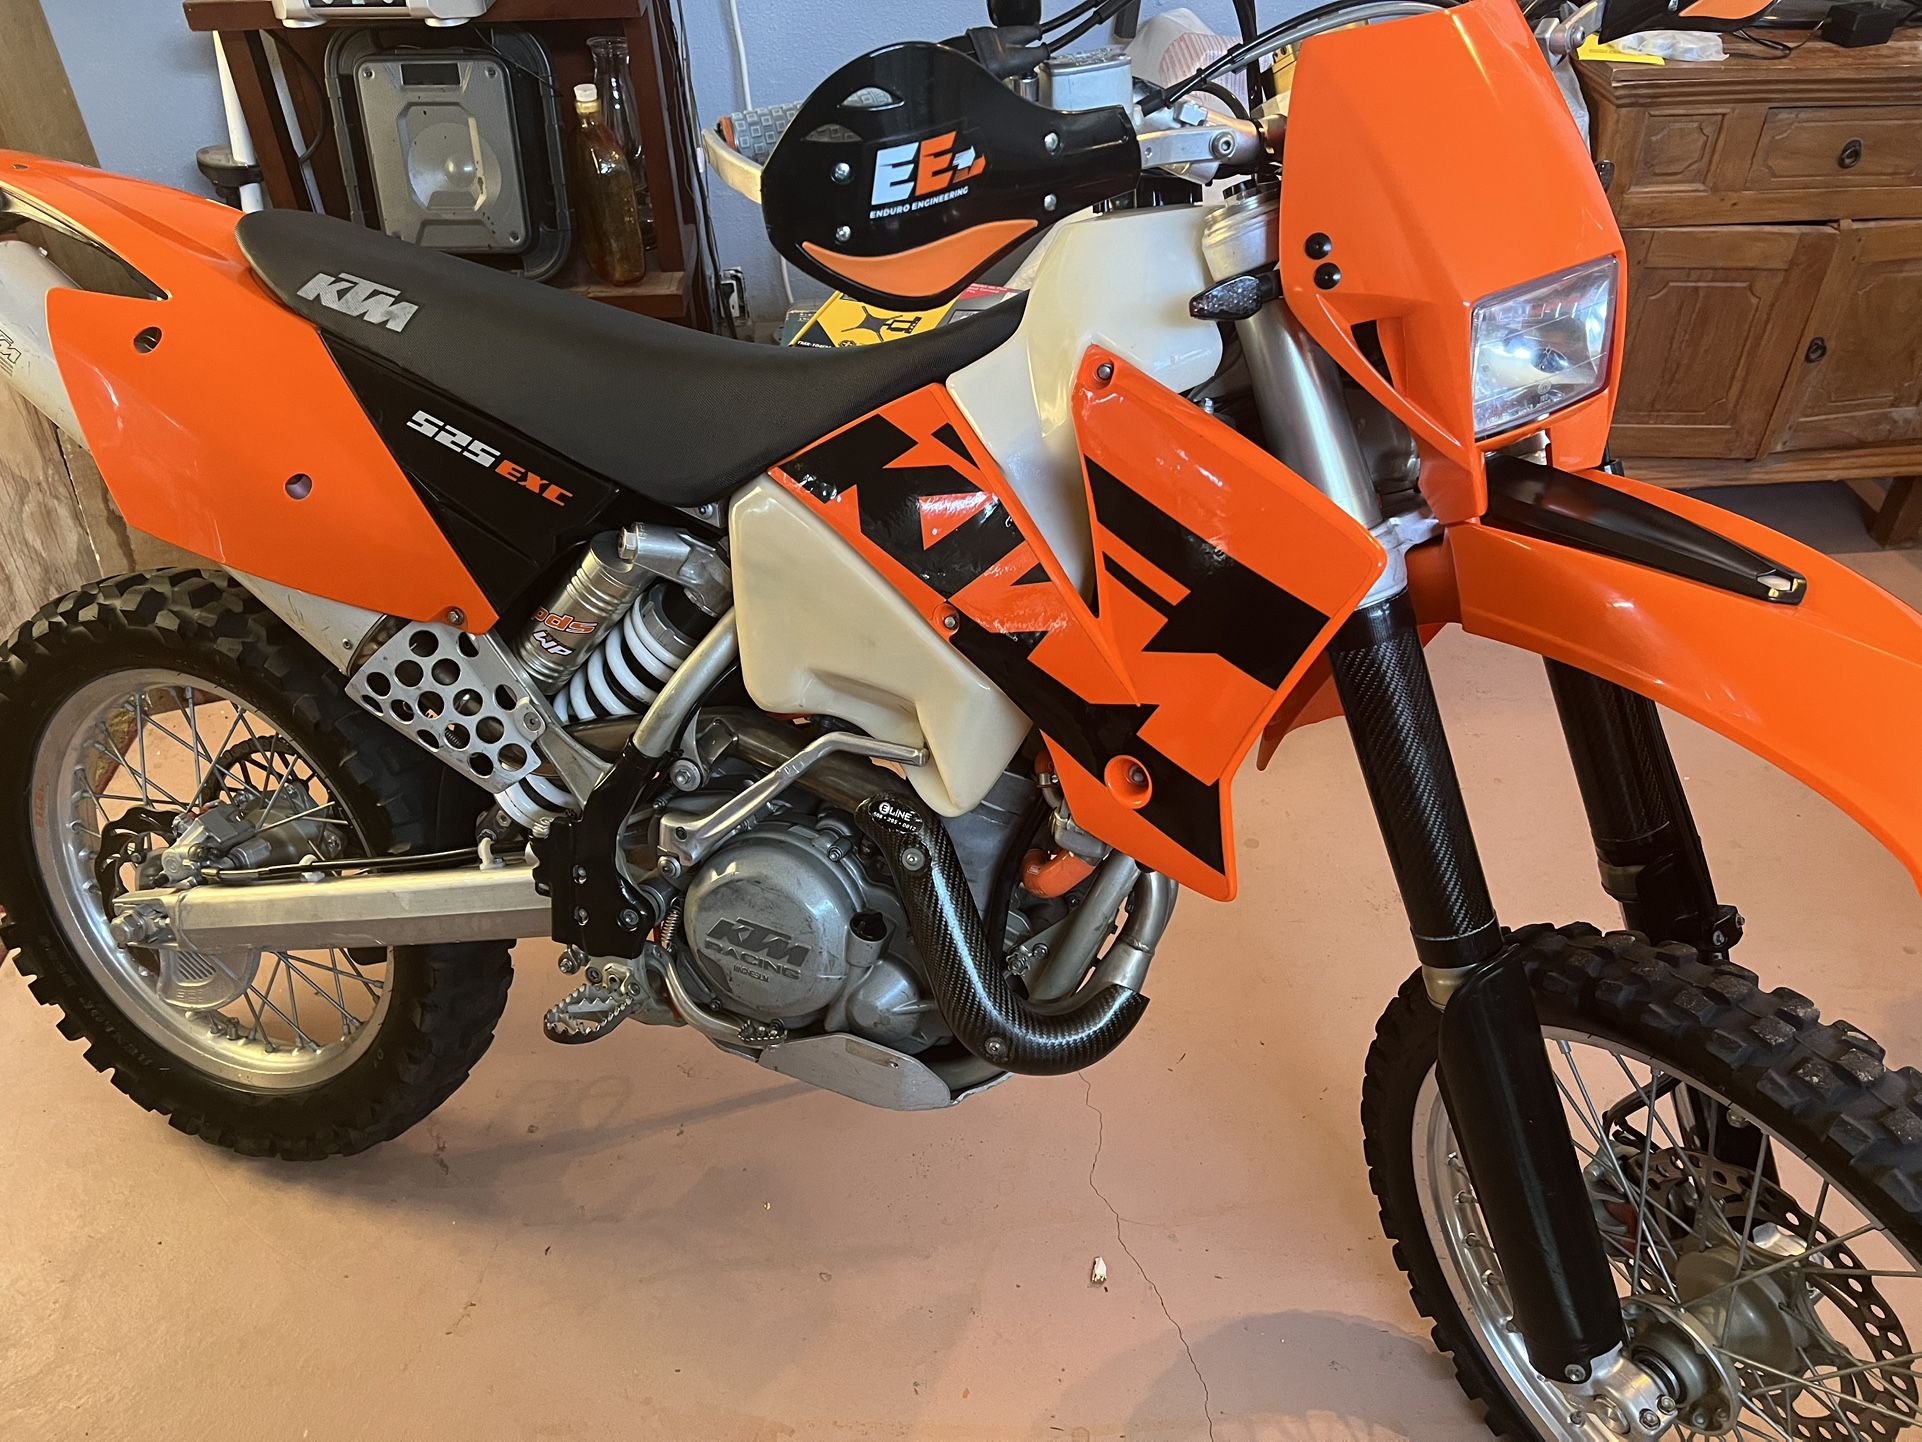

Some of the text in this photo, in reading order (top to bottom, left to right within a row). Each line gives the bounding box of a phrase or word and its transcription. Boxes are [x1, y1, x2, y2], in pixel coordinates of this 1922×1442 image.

[869, 186, 969, 219] ENDURO ENGINEERING
[297, 272, 419, 333] KTM
[406, 410, 574, 507] 525 EXC
[532, 629, 575, 657] WP
[704, 938, 802, 980] RACING
[706, 917, 812, 967] KTM
